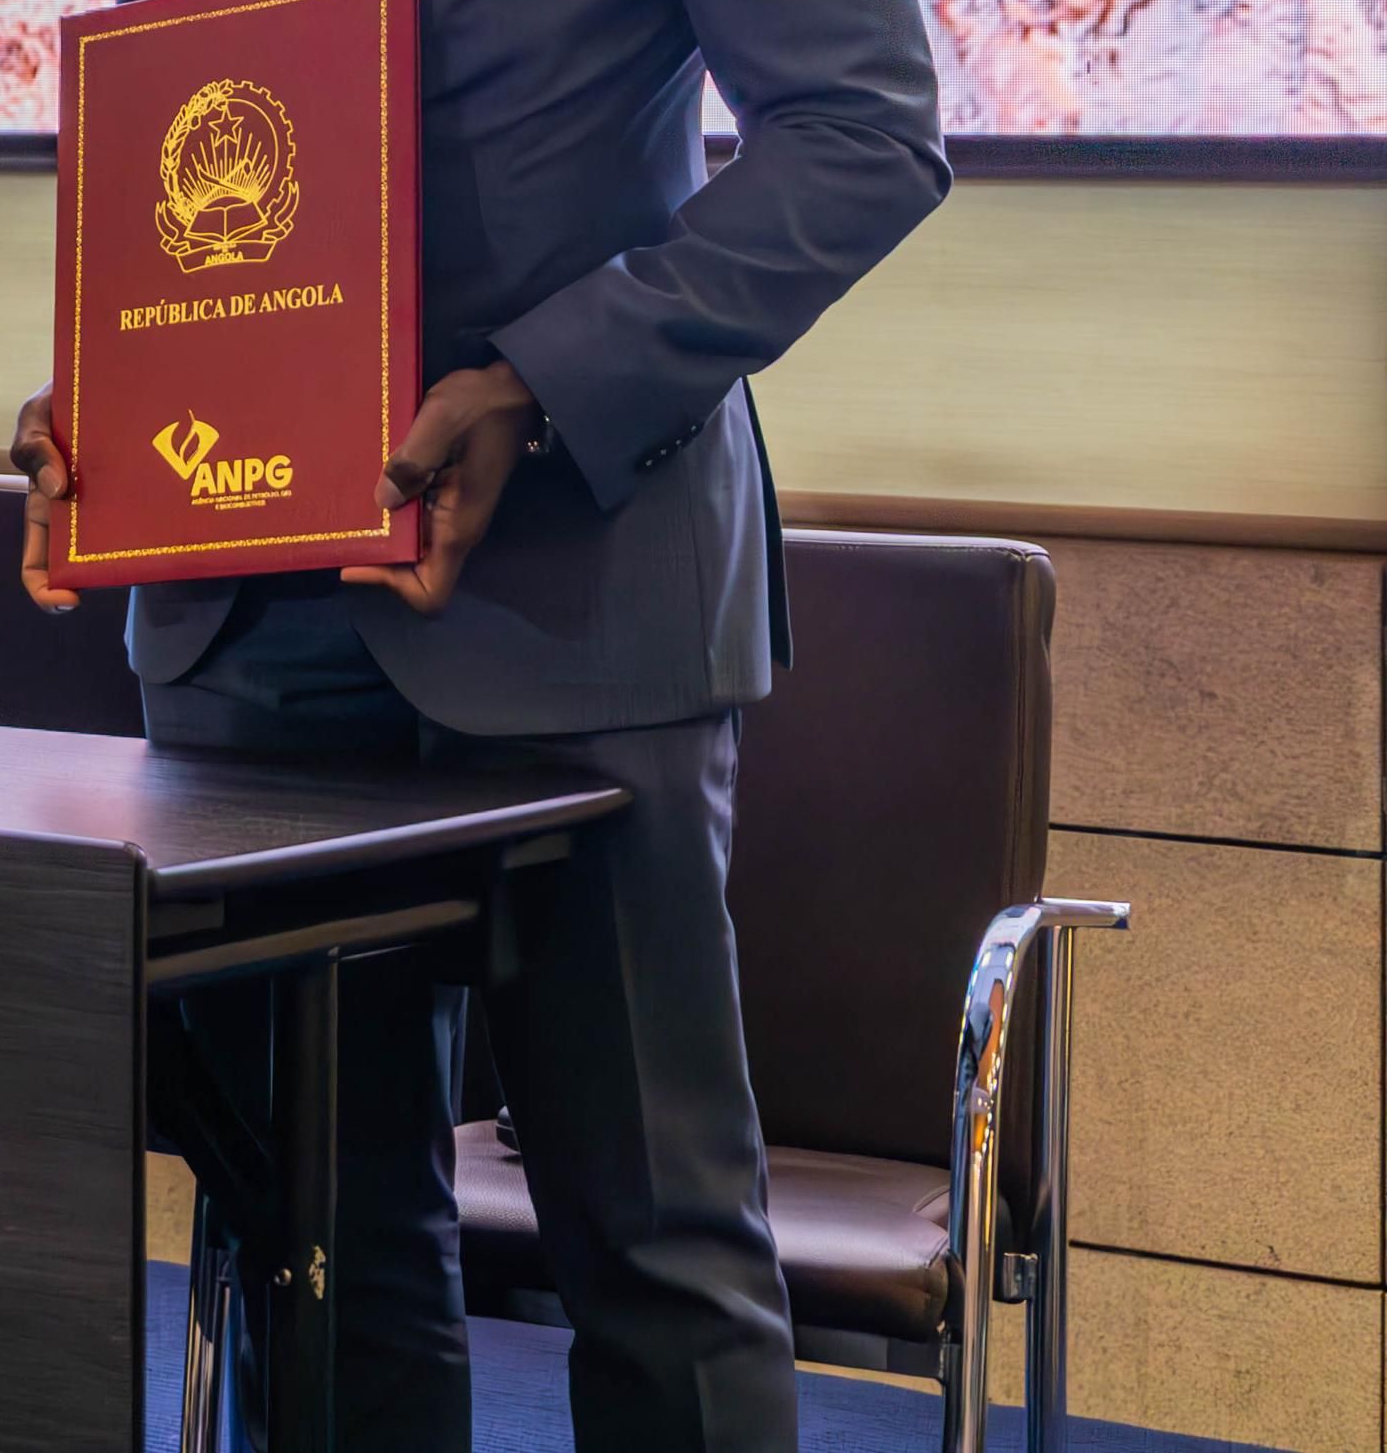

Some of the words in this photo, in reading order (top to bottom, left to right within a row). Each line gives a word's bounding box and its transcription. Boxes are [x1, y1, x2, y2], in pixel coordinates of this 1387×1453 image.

[205, 251, 244, 265] ANGOLA
[120, 299, 226, 331] REPÚBLICA
[229, 294, 256, 317] DE
[259, 283, 344, 313] ANGOLA
[191, 454, 293, 497] ANPG
